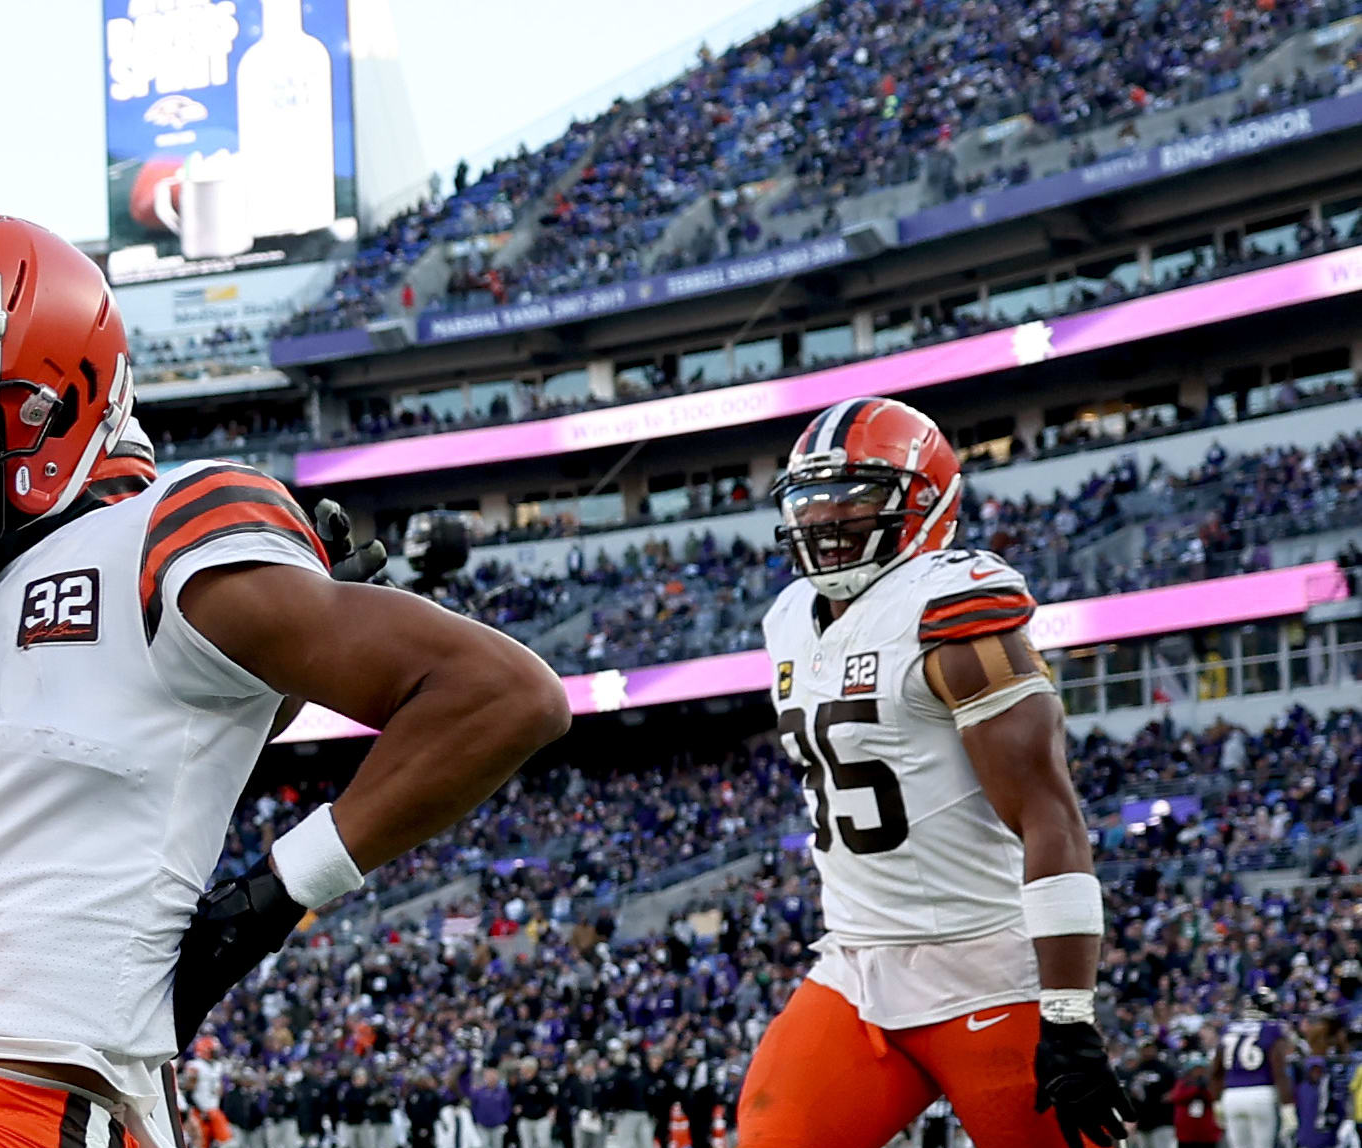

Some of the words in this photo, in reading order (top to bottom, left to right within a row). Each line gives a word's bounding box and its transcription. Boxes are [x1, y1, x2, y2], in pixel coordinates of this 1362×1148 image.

[1160, 133, 1215, 170] RING
[1226, 108, 1312, 152] HONOR
[25, 575, 92, 628] 32
[844, 654, 877, 687] 32
[1221, 1032, 1264, 1071] 76
